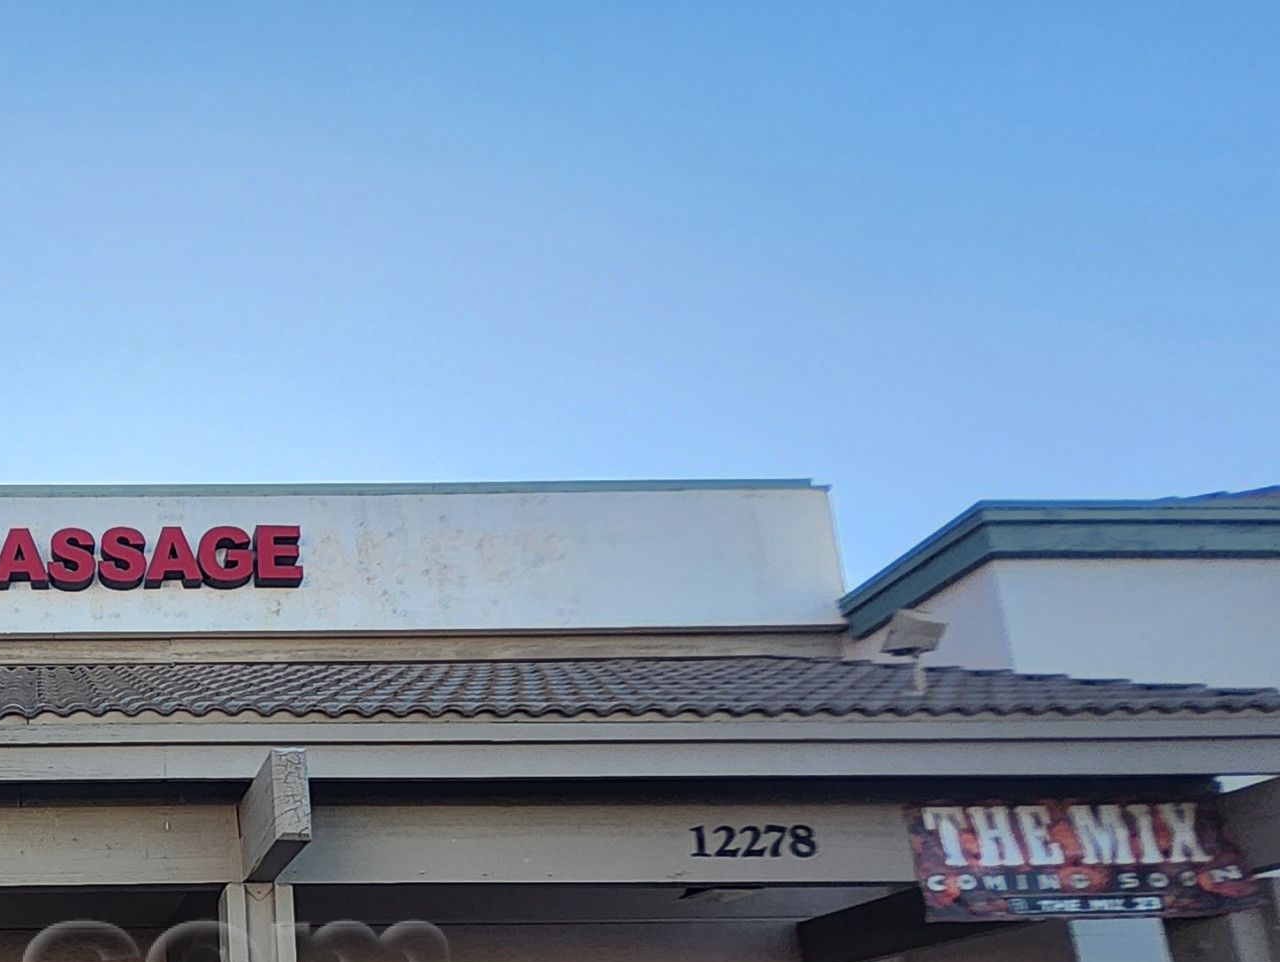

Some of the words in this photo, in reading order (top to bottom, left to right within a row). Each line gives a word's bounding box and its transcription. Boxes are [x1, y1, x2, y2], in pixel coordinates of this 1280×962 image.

[688, 824, 819, 858] 12278
[920, 803, 1066, 867] THE
[1068, 801, 1214, 866] MIX
